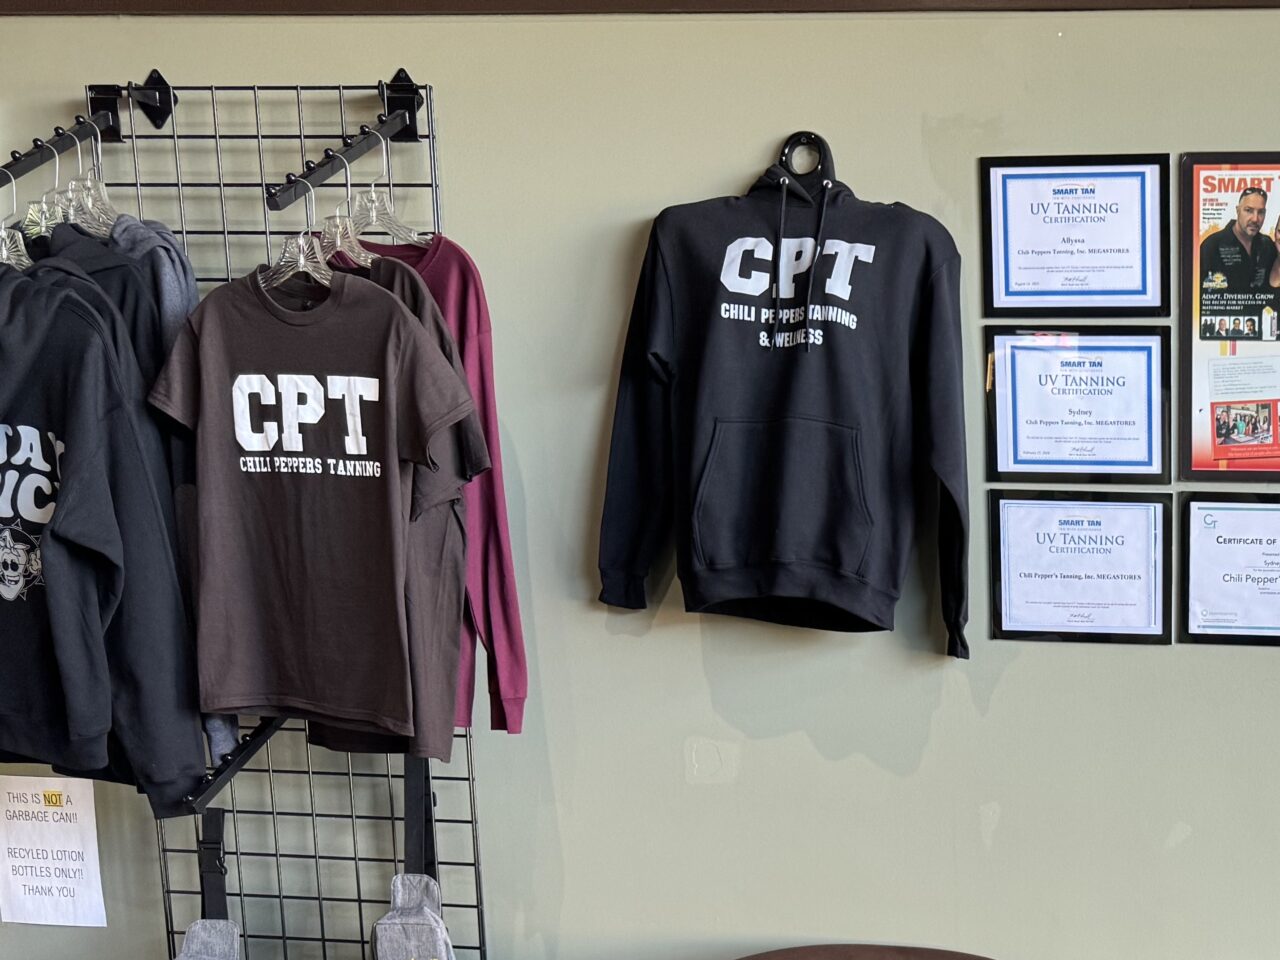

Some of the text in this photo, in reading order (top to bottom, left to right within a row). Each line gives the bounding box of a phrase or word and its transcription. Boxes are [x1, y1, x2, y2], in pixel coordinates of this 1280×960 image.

[1203, 175, 1274, 193] SMART
[1031, 202, 1118, 215] UV TANNING
[1043, 216, 1105, 224] CERTIFICATION
[720, 237, 875, 300] CPT
[720, 303, 755, 322] CHILI
[809, 304, 857, 330] TANNING
[759, 331, 771, 347] &
[1038, 374, 1125, 387] UV TANNING
[1051, 387, 1113, 395] CERTIFICATION
[232, 374, 379, 455] CPT
[1068, 409, 1092, 417] Sydney
[240, 457, 381, 478] CHILI PEPPERS TANNING
[1036, 533, 1125, 546] UV TANNING
[1216, 535, 1263, 545] CERTIFICATE
[1049, 545, 1111, 555] CERTIFICATION
[1222, 574, 1242, 583] Chili
[6, 792, 73, 806] THIS IS NOT A
[6, 810, 78, 823] GARBAGE CAN!!
[7, 847, 84, 861] RECYLED LOTION
[12, 865, 83, 880] BOTTLES ONLY!!
[22, 884, 75, 898] THANK YOU
